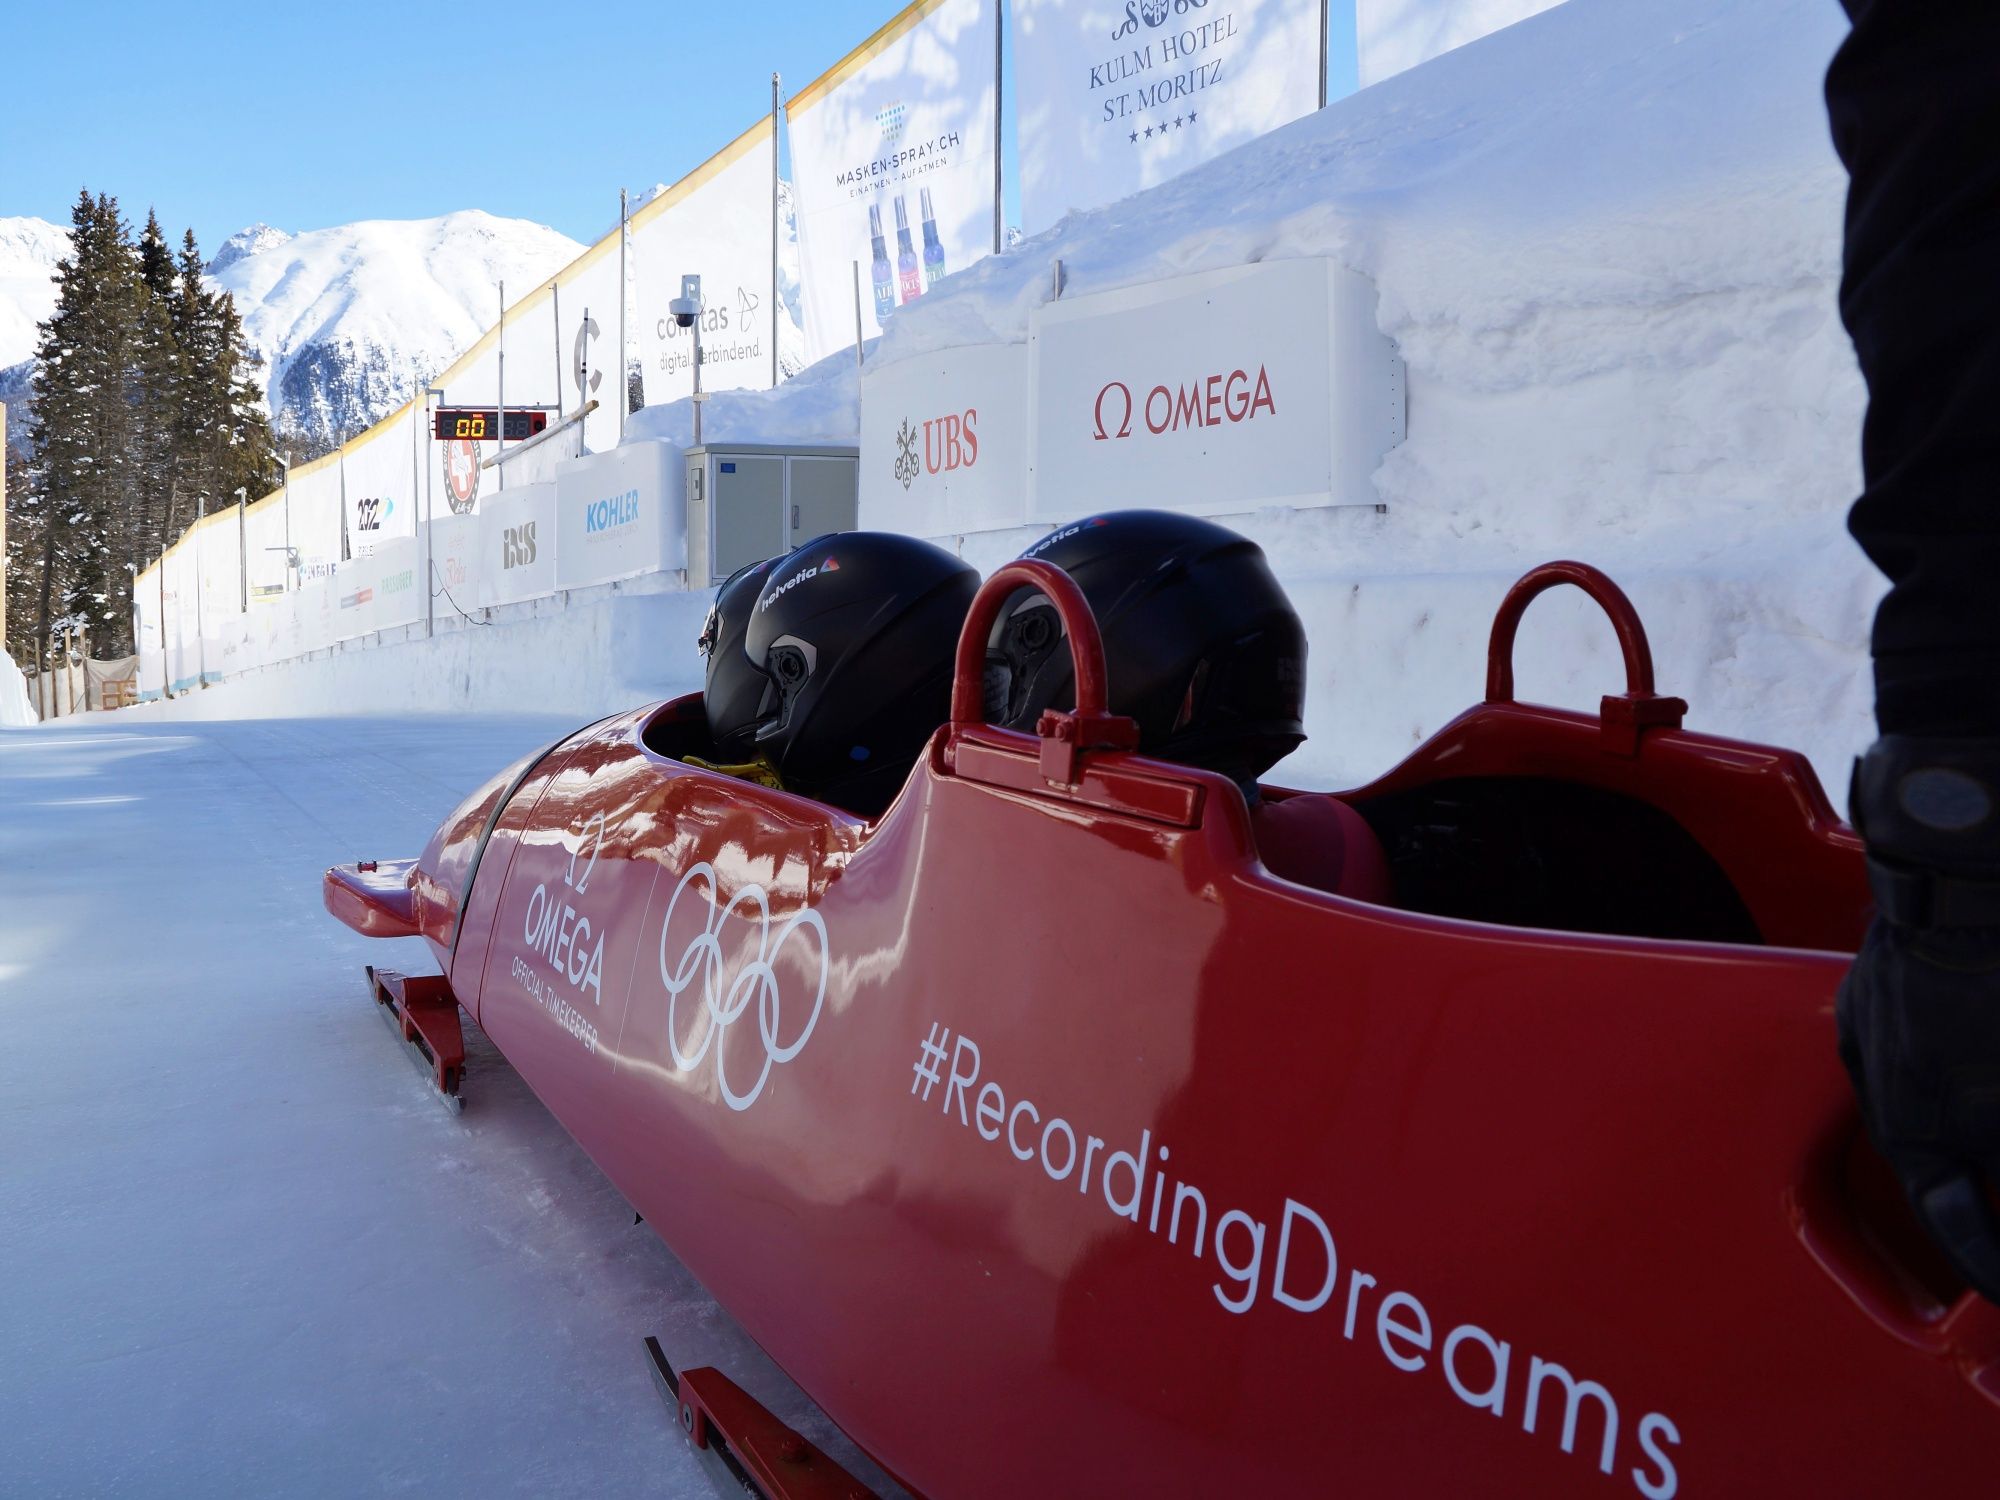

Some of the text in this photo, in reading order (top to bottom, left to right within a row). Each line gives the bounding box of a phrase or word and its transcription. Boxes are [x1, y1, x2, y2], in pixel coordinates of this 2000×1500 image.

[1089, 13, 1238, 89] KULM HOTEL
[1103, 58, 1223, 122] ST. MORITZ
[836, 131, 960, 187] MASKEN-SPRAY.CH
[657, 304, 728, 340] cotas
[1145, 363, 1276, 435] OMEGA
[922, 408, 979, 474] UBS
[586, 489, 639, 533] KOHLER
[761, 567, 817, 613] helvetia
[524, 883, 605, 1006] OMEGA
[512, 956, 598, 1055] OFFICIAL TIMEKEEPER
[911, 1022, 1682, 1500] #RecordingDreams
